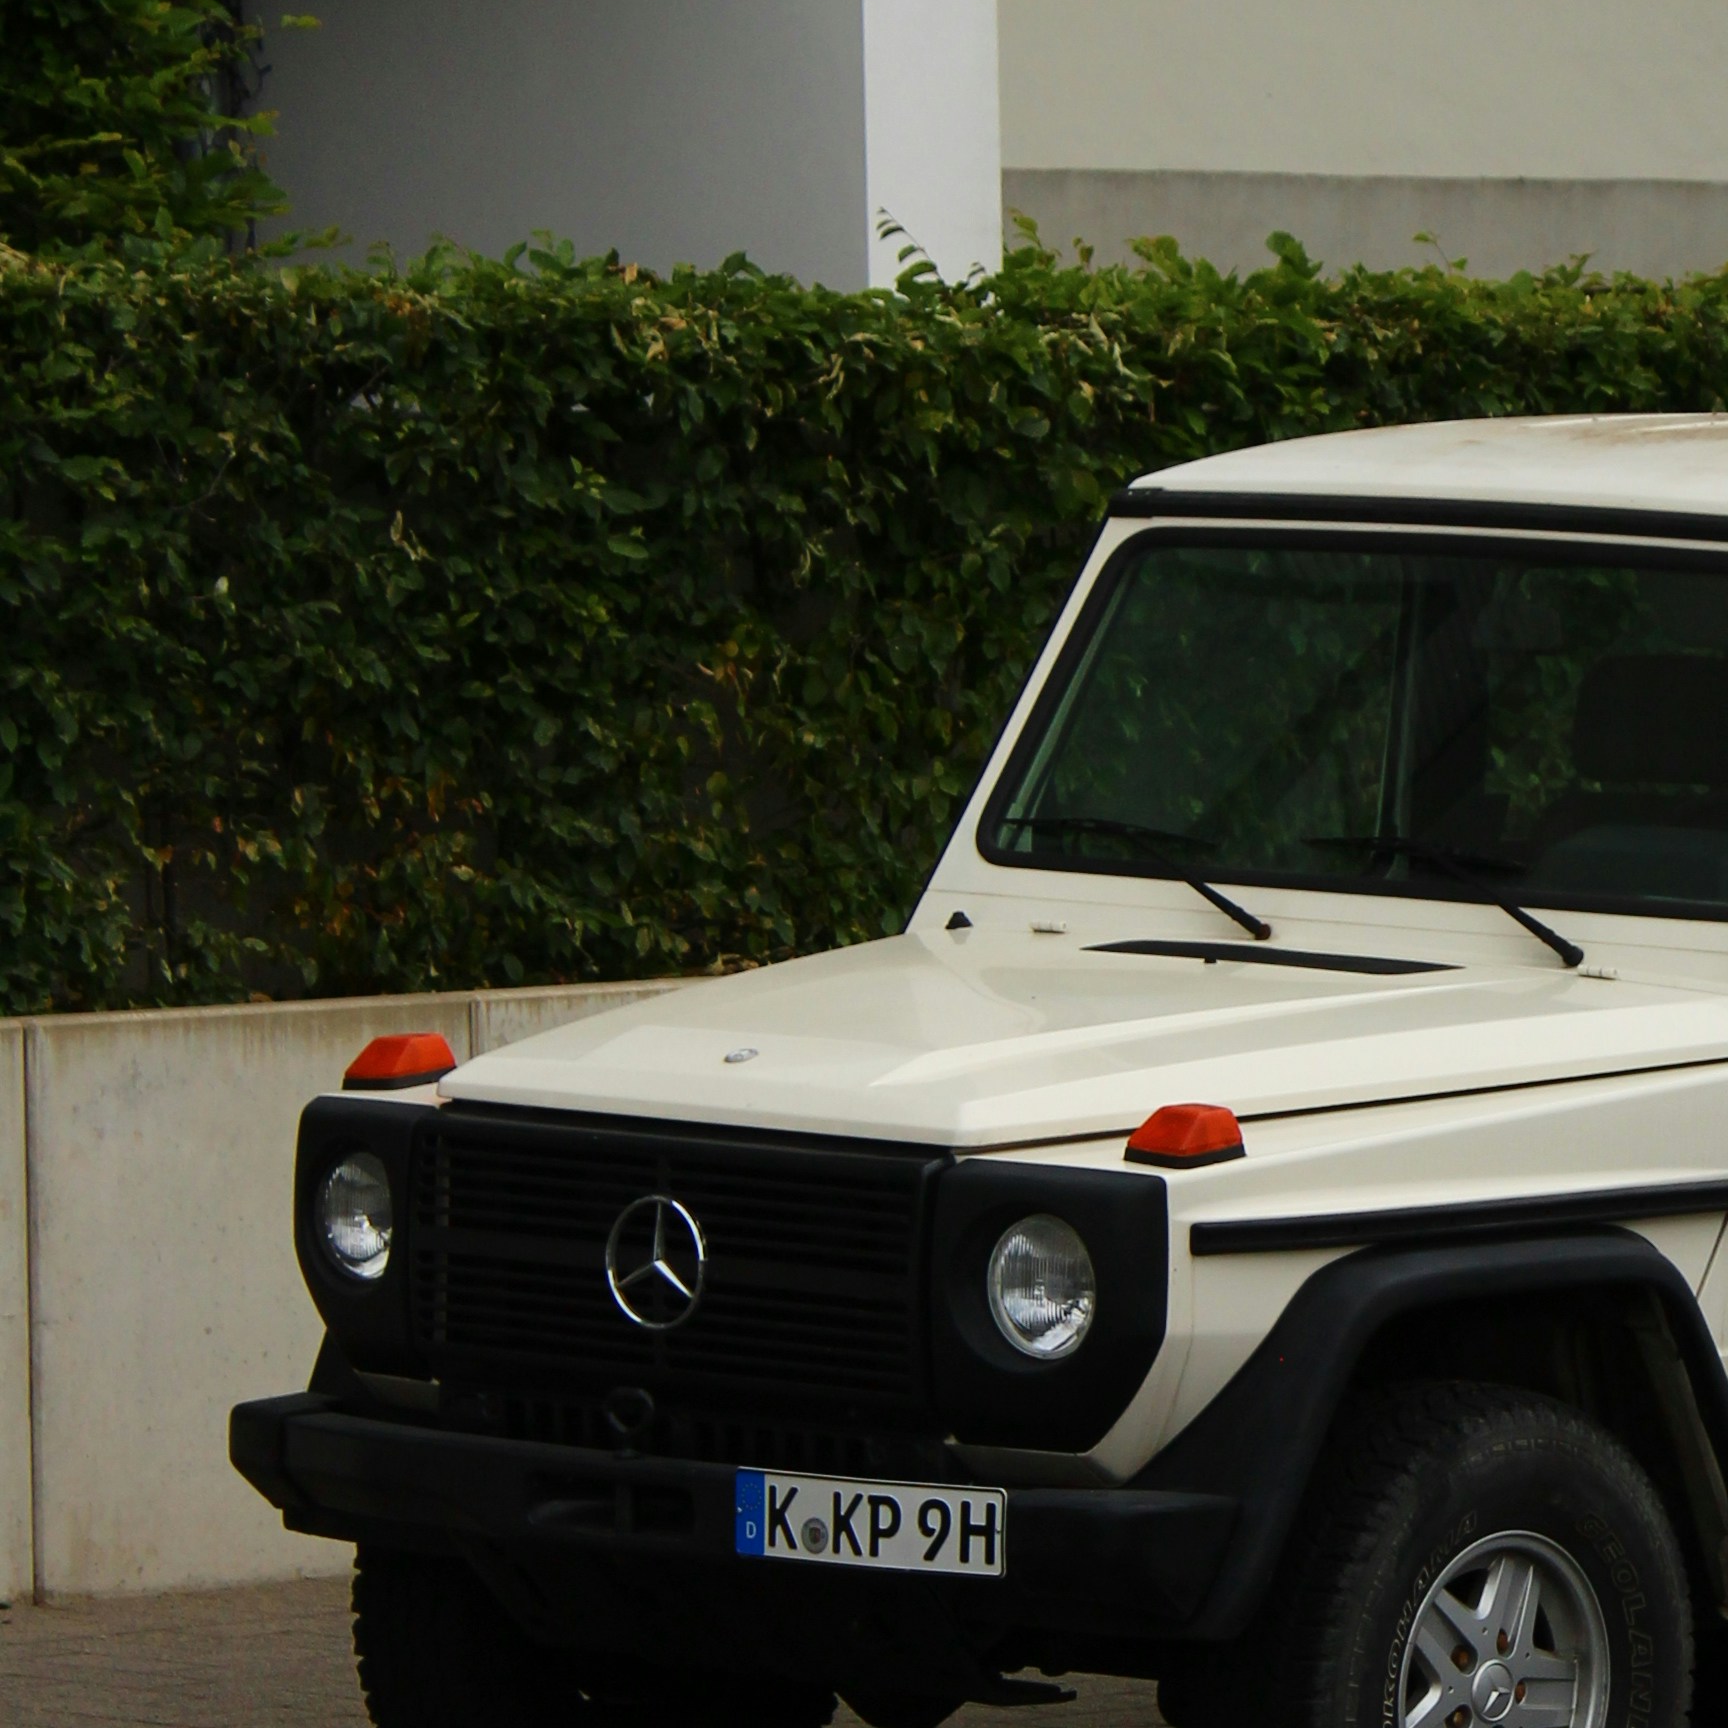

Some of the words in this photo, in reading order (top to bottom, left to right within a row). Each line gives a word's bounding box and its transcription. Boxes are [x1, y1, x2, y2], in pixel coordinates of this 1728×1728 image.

[745, 1521, 757, 1539] D
[768, 1484, 799, 1550] K
[832, 1491, 902, 1557] KP
[917, 1498, 997, 1565] 9H
